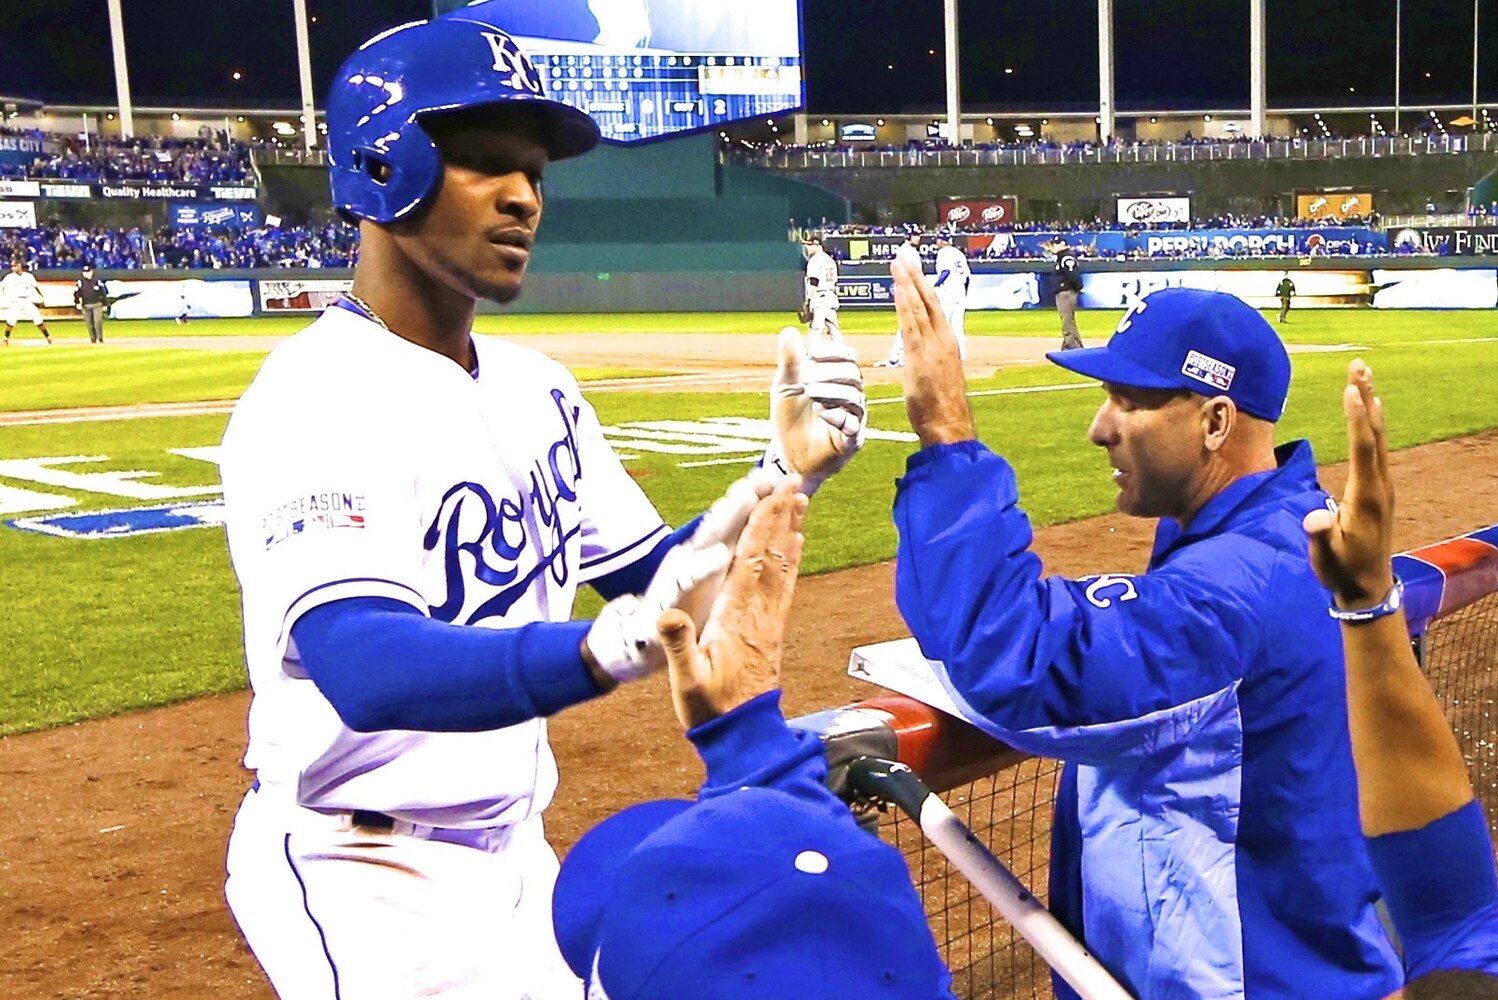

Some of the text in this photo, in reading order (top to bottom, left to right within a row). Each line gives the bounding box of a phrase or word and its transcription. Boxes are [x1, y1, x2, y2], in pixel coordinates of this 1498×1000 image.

[103, 186, 197, 199] Quality Healthcare
[836, 285, 869, 297] LIVE
